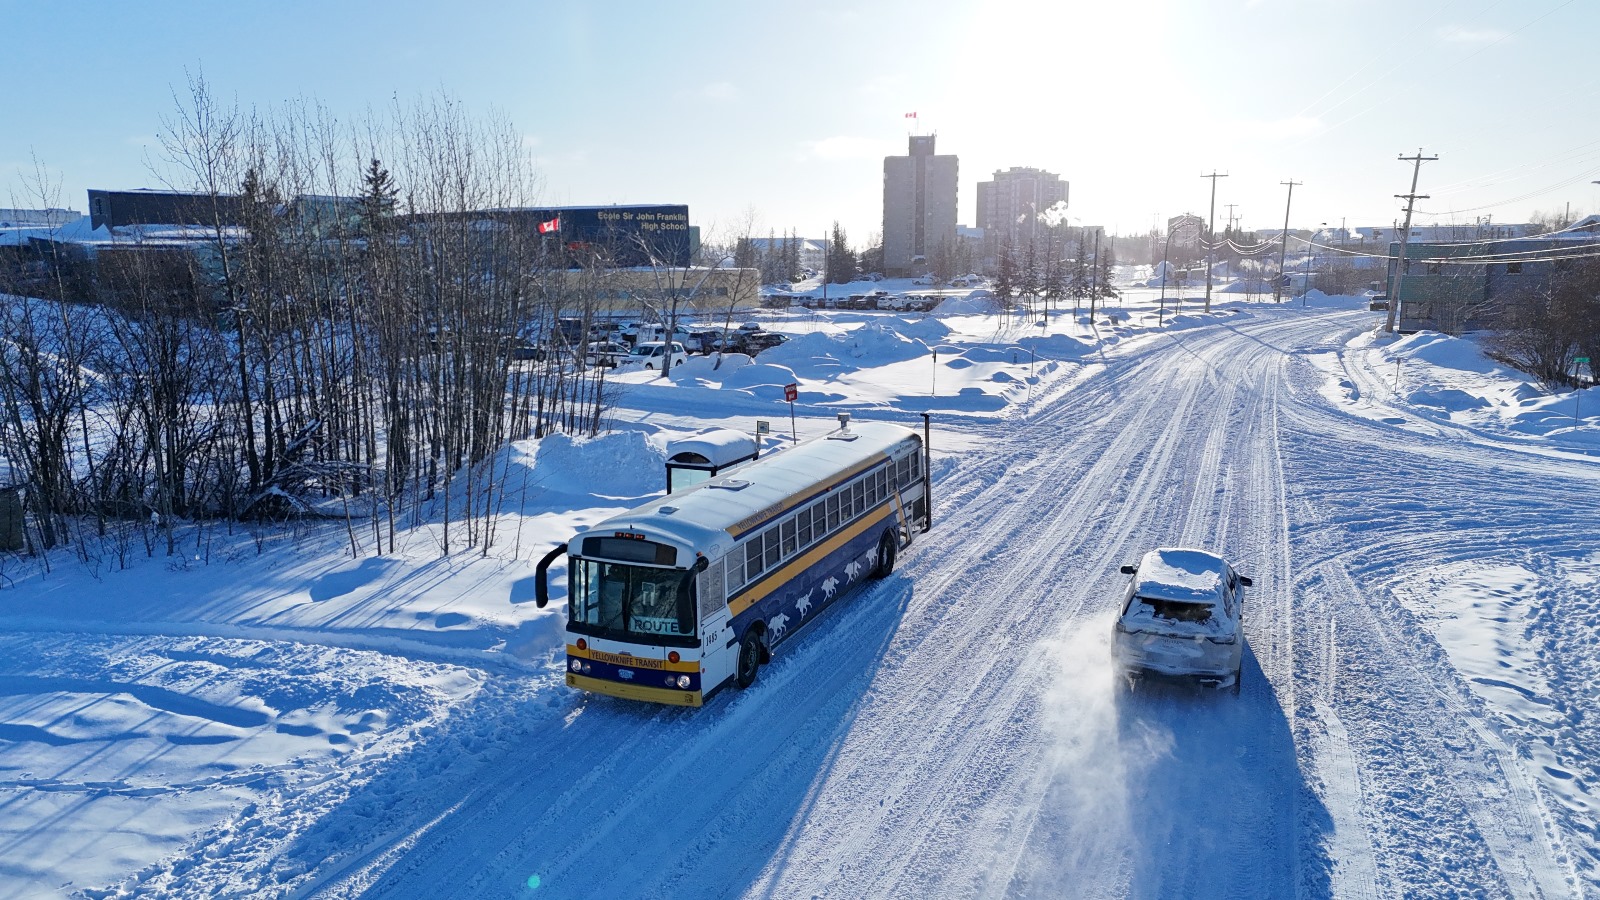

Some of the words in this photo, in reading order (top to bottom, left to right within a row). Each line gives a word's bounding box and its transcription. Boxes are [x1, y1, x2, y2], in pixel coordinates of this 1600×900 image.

[636, 212, 654, 220] John
[641, 222, 659, 231] High
[634, 620, 678, 632] ROUTE
[706, 630, 718, 646] 1485
[591, 652, 632, 665] YELLOWKNIFE
[635, 658, 662, 668] TRANSIT
